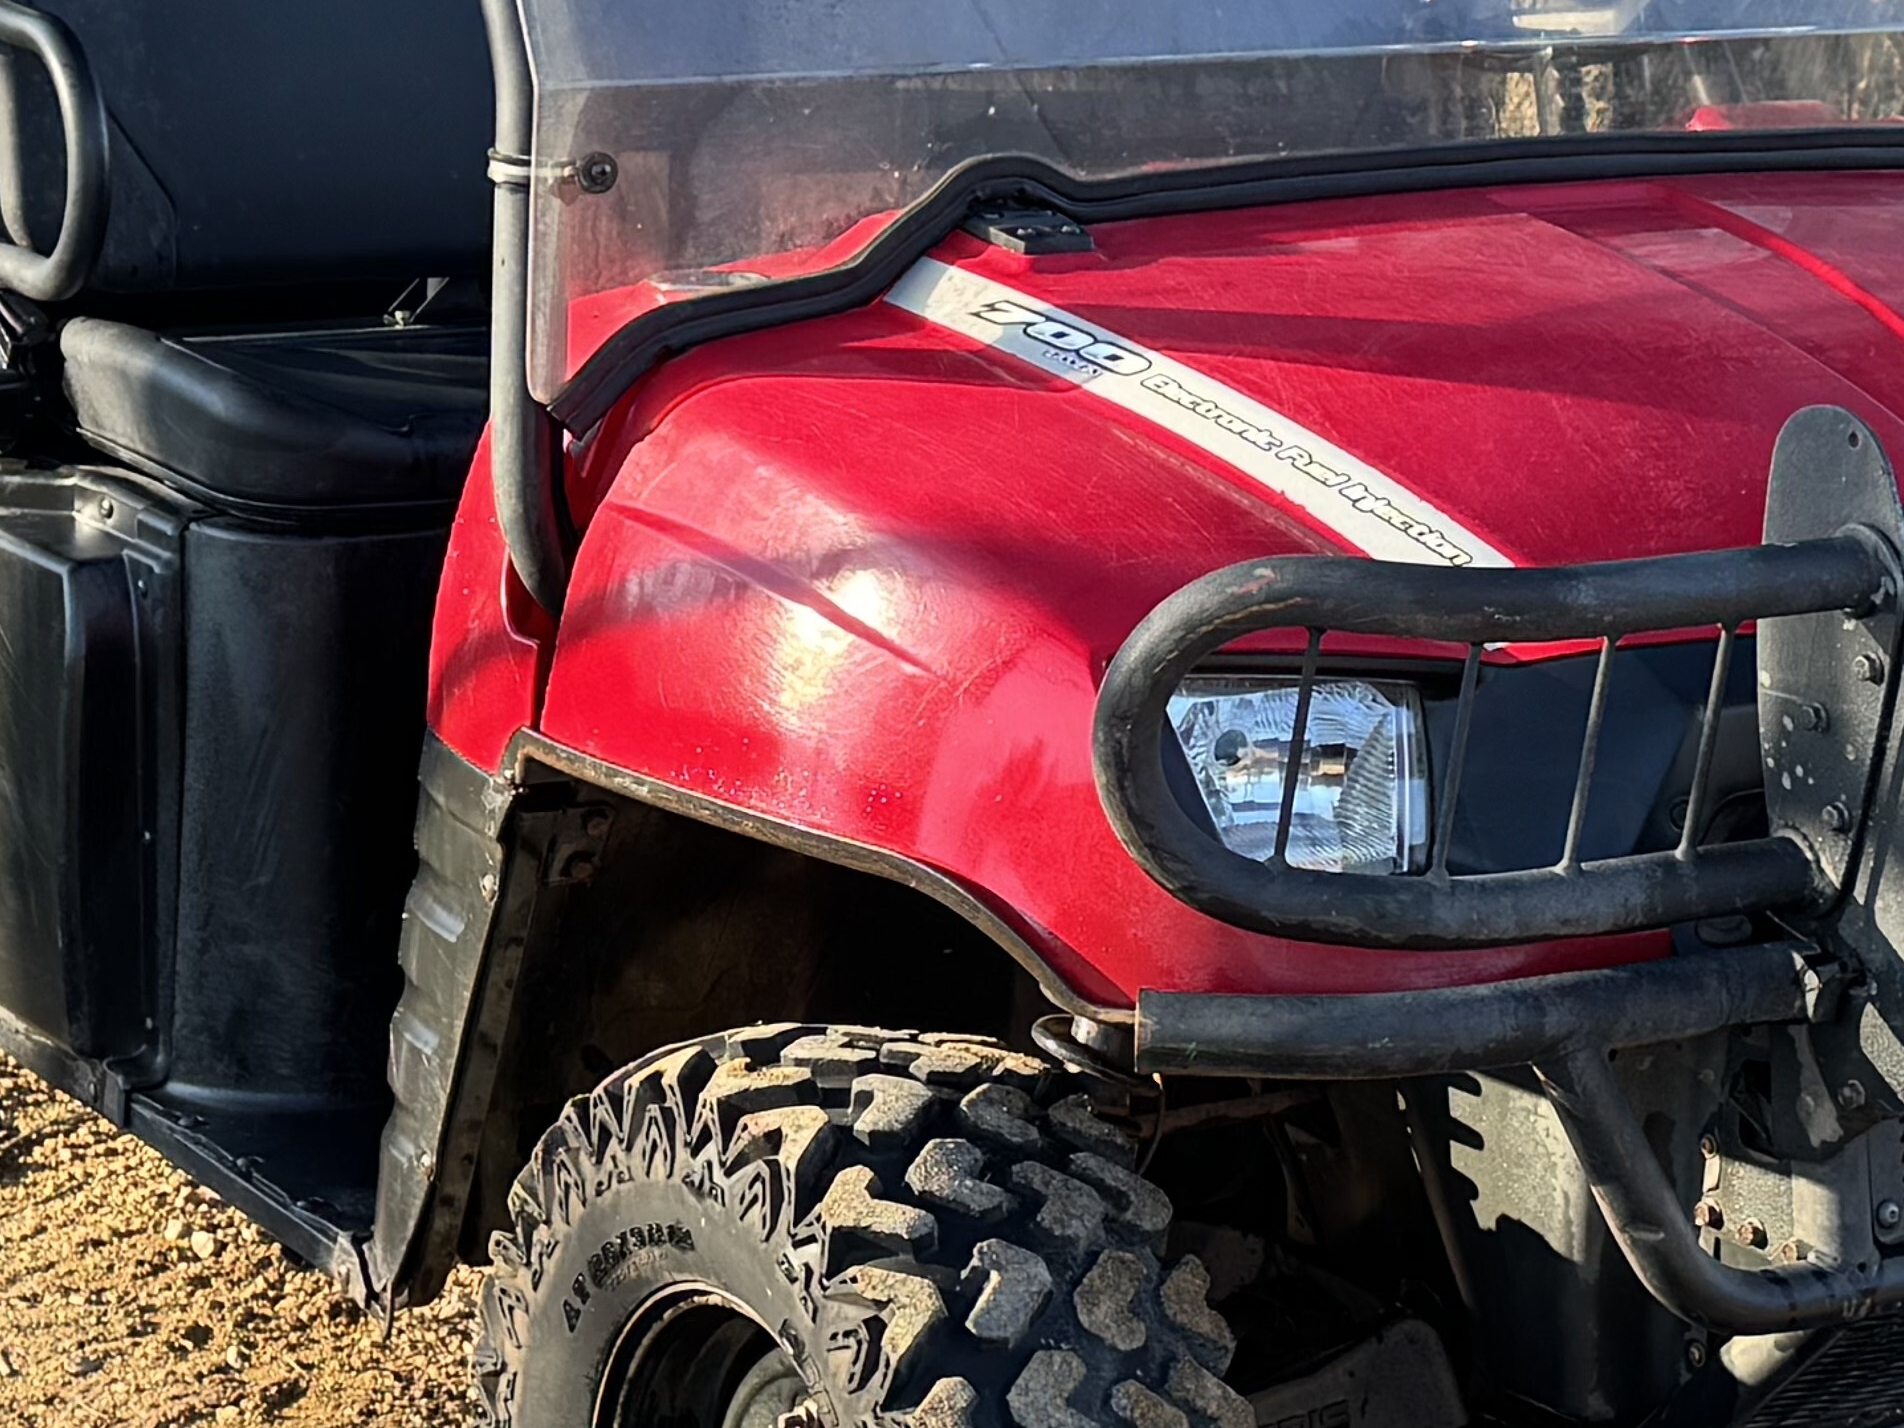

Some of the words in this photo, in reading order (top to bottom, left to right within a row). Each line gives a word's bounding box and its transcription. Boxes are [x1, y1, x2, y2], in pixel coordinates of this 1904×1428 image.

[968, 300, 1153, 376] 700
[1140, 373, 1284, 452] Electronic
[1275, 444, 1351, 488] Fuel
[1338, 482, 1474, 568] Injection
